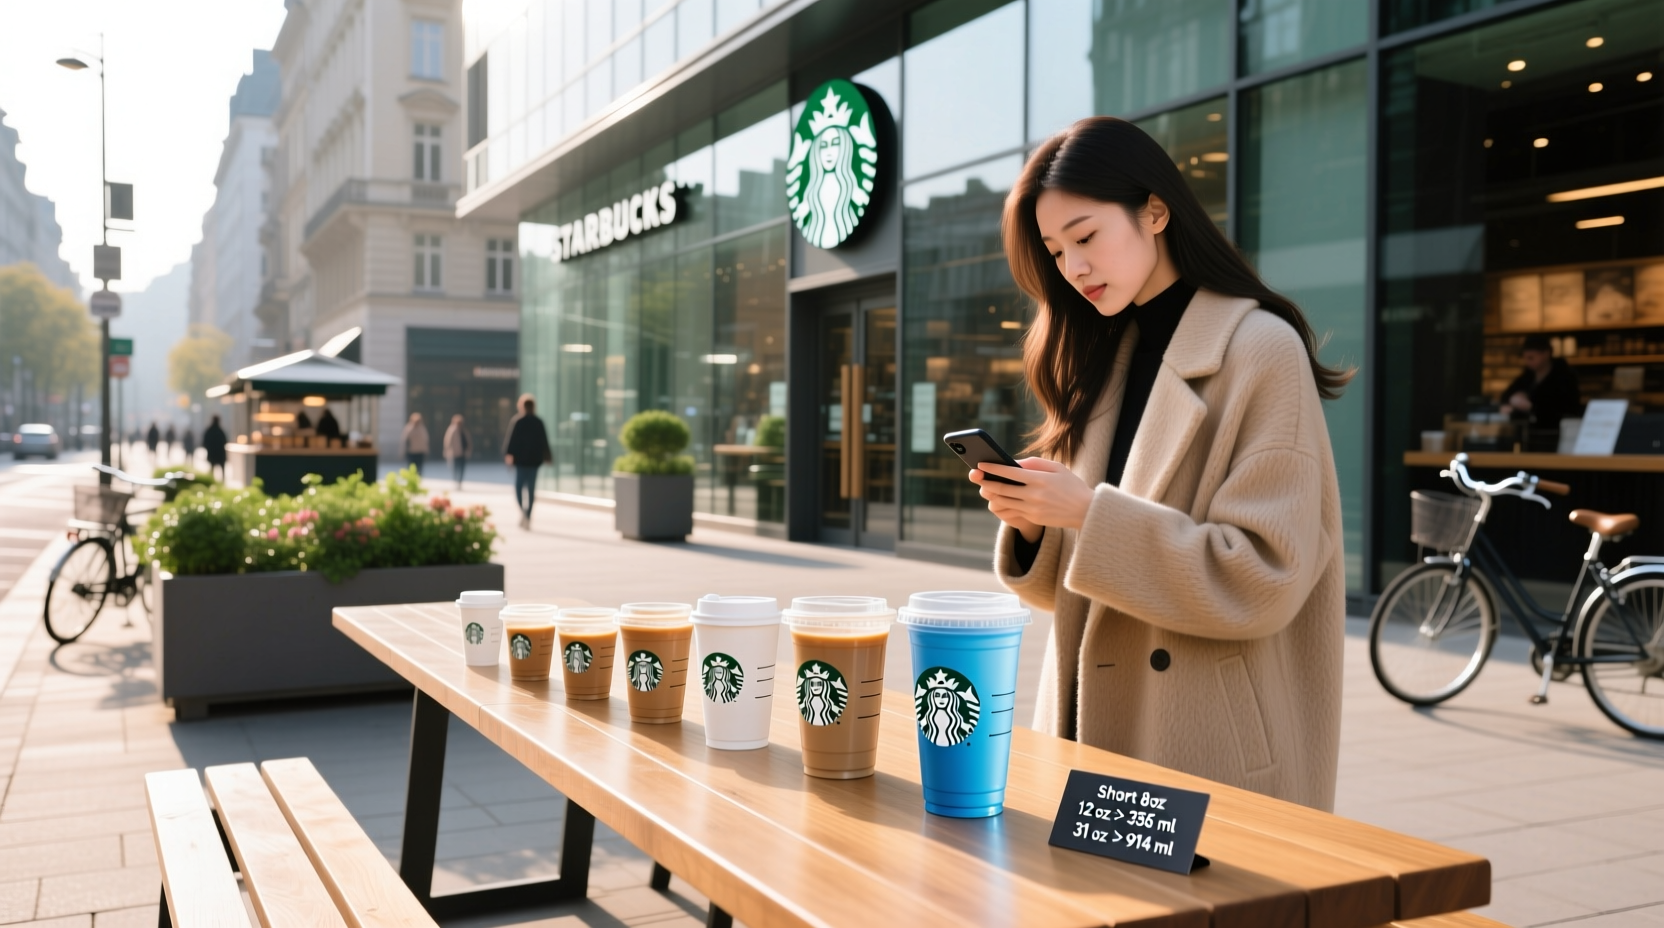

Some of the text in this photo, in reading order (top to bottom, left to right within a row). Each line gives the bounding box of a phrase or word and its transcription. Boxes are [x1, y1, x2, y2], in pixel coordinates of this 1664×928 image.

[550, 180, 677, 264] STARBUCKS
[1097, 785, 1168, 810] Short 8oz
[1078, 800, 1095, 816] 12
[1095, 808, 1111, 821] oz
[1157, 817, 1177, 833] ml
[1072, 821, 1090, 839] 31
[1091, 830, 1109, 843] oz
[1126, 832, 1151, 851] 914
[1153, 841, 1174, 856] ml
